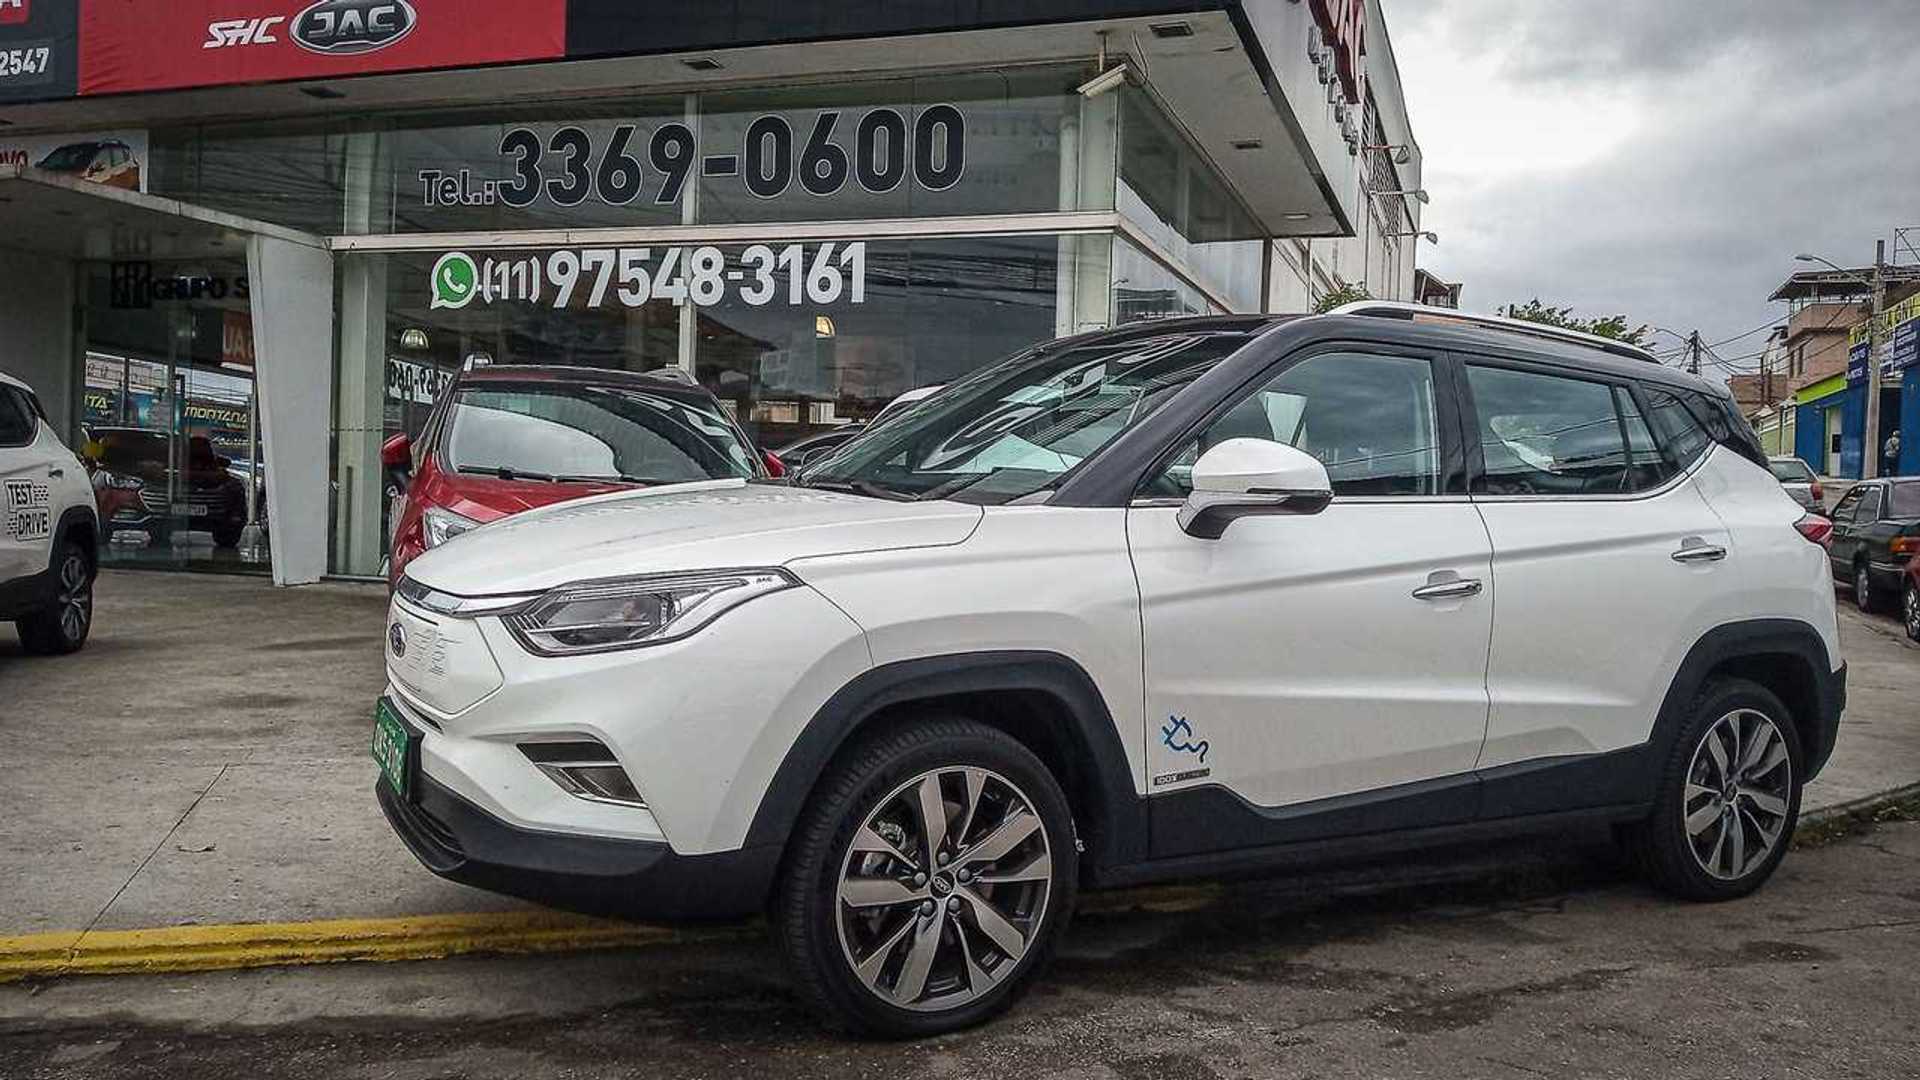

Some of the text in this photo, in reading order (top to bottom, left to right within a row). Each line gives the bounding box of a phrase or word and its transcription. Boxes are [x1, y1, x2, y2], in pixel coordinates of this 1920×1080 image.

[202, 5, 396, 50] SHC JAC
[0, 47, 50, 76] 2547
[497, 103, 967, 208] 3369-0600
[152, 276, 228, 300] GRUPO
[482, 241, 867, 309] (11) 97548-3161
[8, 483, 33, 505] TEST
[18, 512, 48, 536] DRIVE
